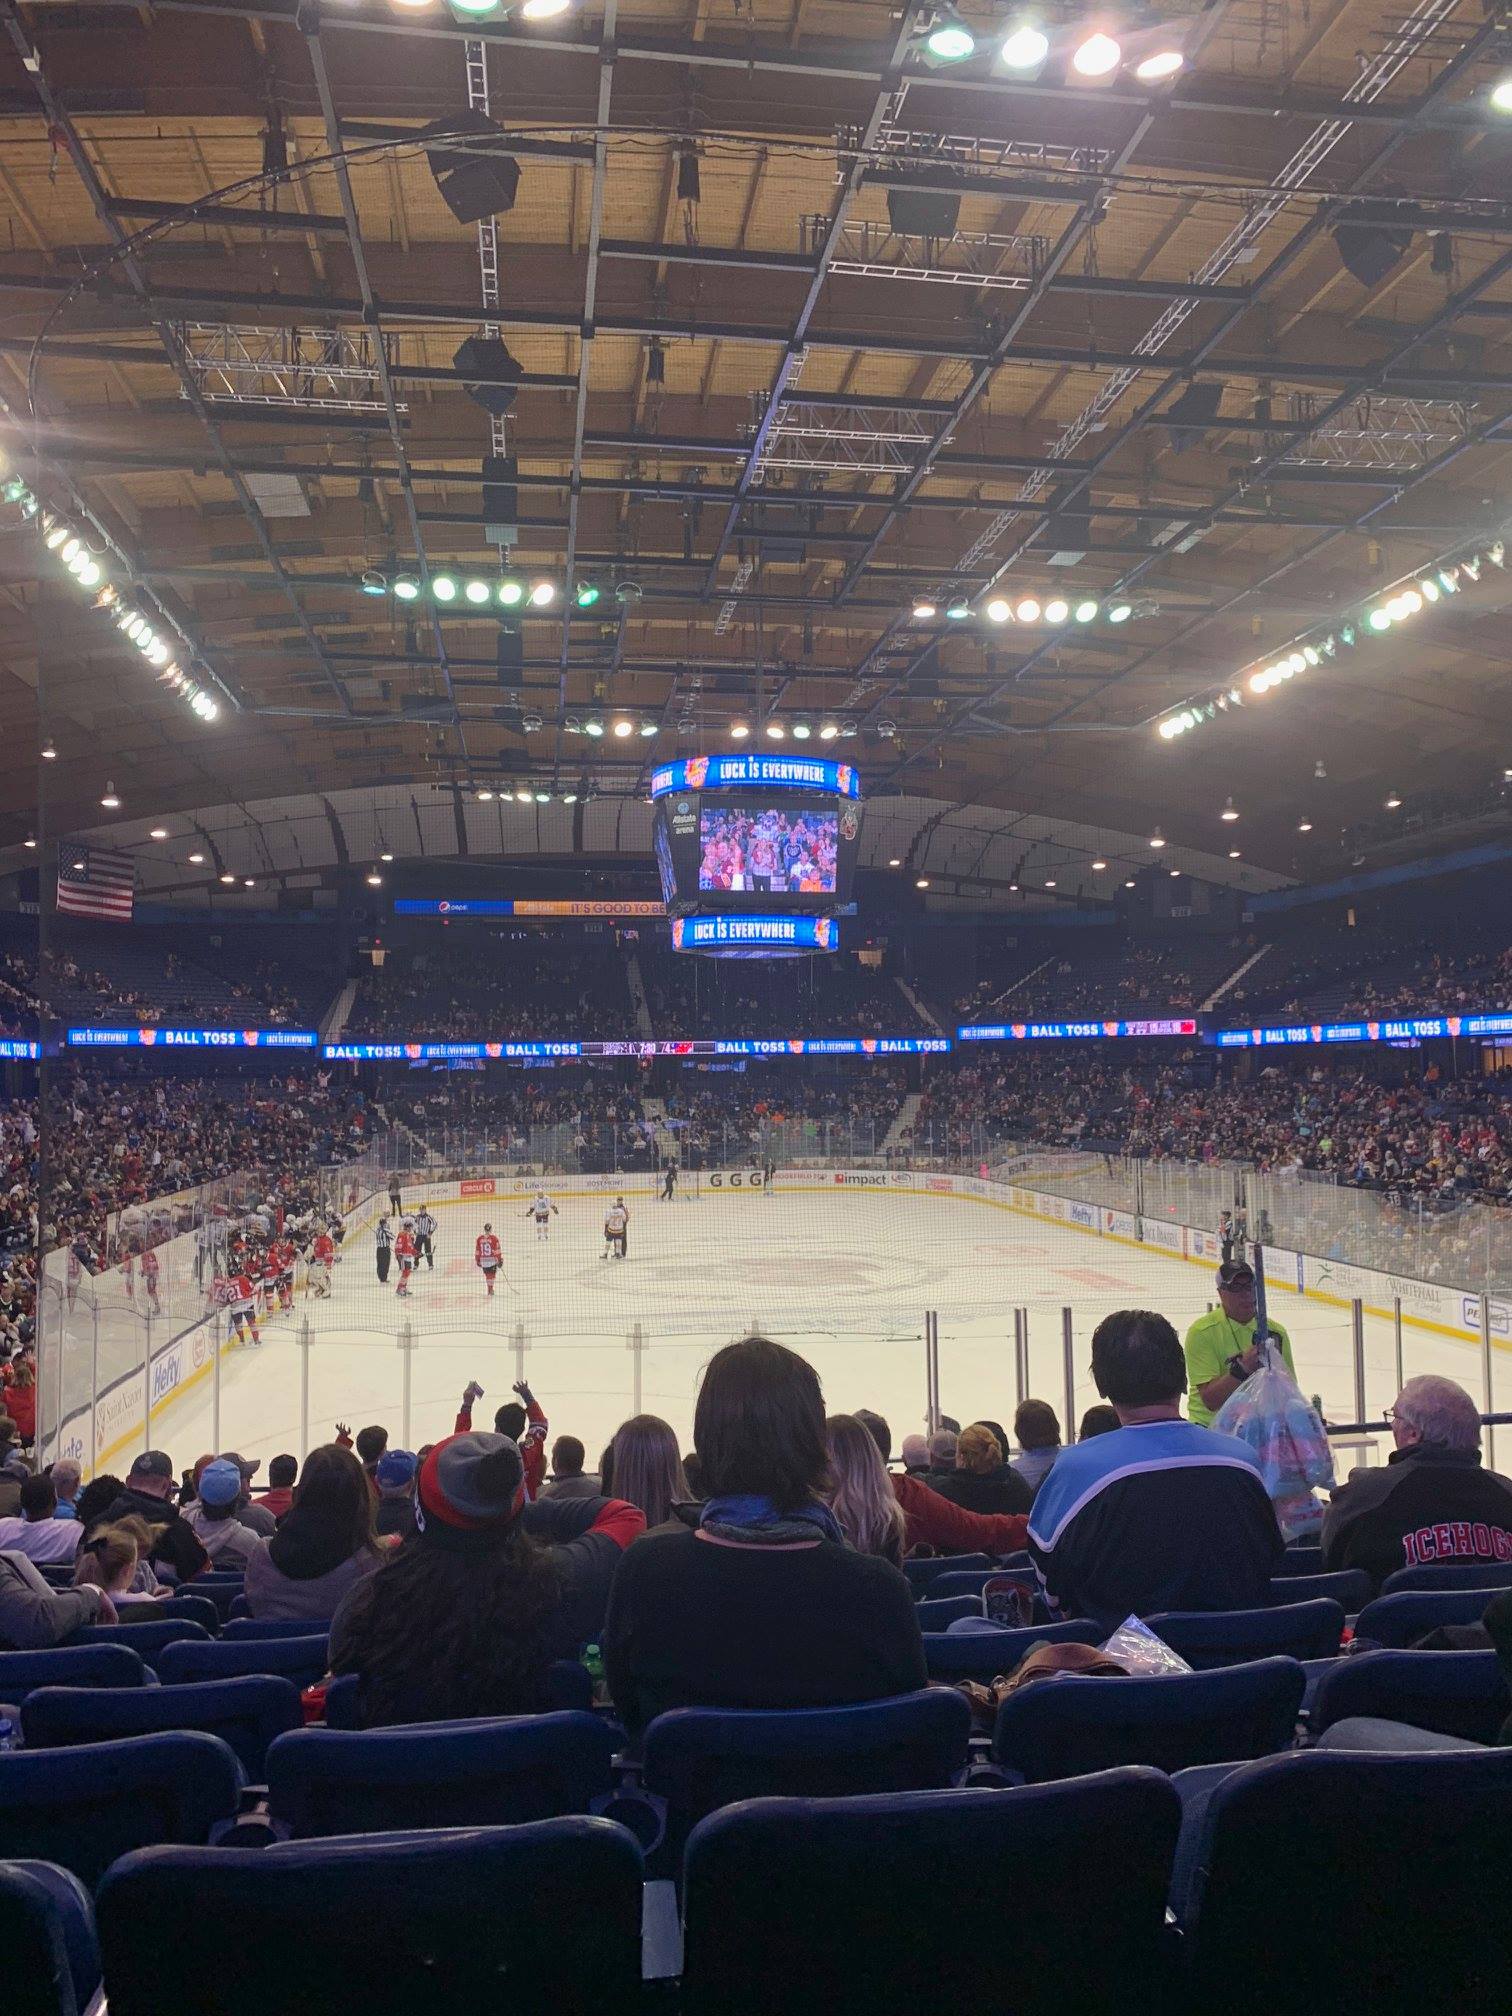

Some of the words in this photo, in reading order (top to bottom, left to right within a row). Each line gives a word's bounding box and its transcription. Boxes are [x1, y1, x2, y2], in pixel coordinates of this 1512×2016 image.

[720, 763, 745, 779] LUCK
[762, 764, 825, 783] EVERYWHERE
[672, 814, 697, 824] Allstate
[675, 826, 694, 835] arena
[571, 904, 590, 914] IT'S
[593, 904, 632, 914] GOOD
[634, 904, 649, 914] TO
[694, 923, 714, 939] LUCK
[729, 923, 795, 939] EVERYWHERE
[1031, 1026, 1062, 1037] BALL
[1066, 1024, 1098, 1036] TOSS
[1265, 1030, 1285, 1042] BALL
[1287, 1029, 1307, 1042] TOSS
[1385, 1023, 1411, 1037] BALL
[1413, 1021, 1441, 1036] TOSS
[165, 1032, 199, 1044] BALL
[203, 1032, 236, 1044] TOSS
[0, 1043, 11, 1055] ALL
[13, 1043, 27, 1056] TOSS
[325, 1047, 362, 1058] BALL
[365, 1046, 401, 1058] TOSS
[506, 1045, 540, 1056] BALL
[544, 1044, 577, 1055] TOSS
[717, 1042, 749, 1053] BALL
[753, 1042, 785, 1053] TOSS
[881, 1041, 911, 1052] BALL
[916, 1040, 947, 1052] TOSS
[845, 1172, 887, 1186] impact
[463, 1185, 483, 1194] CIRCLE
[1072, 1205, 1092, 1226] Hefty
[480, 1242, 491, 1256] 19
[226, 1284, 243, 1302] 21
[154, 1355, 180, 1398] Hefty
